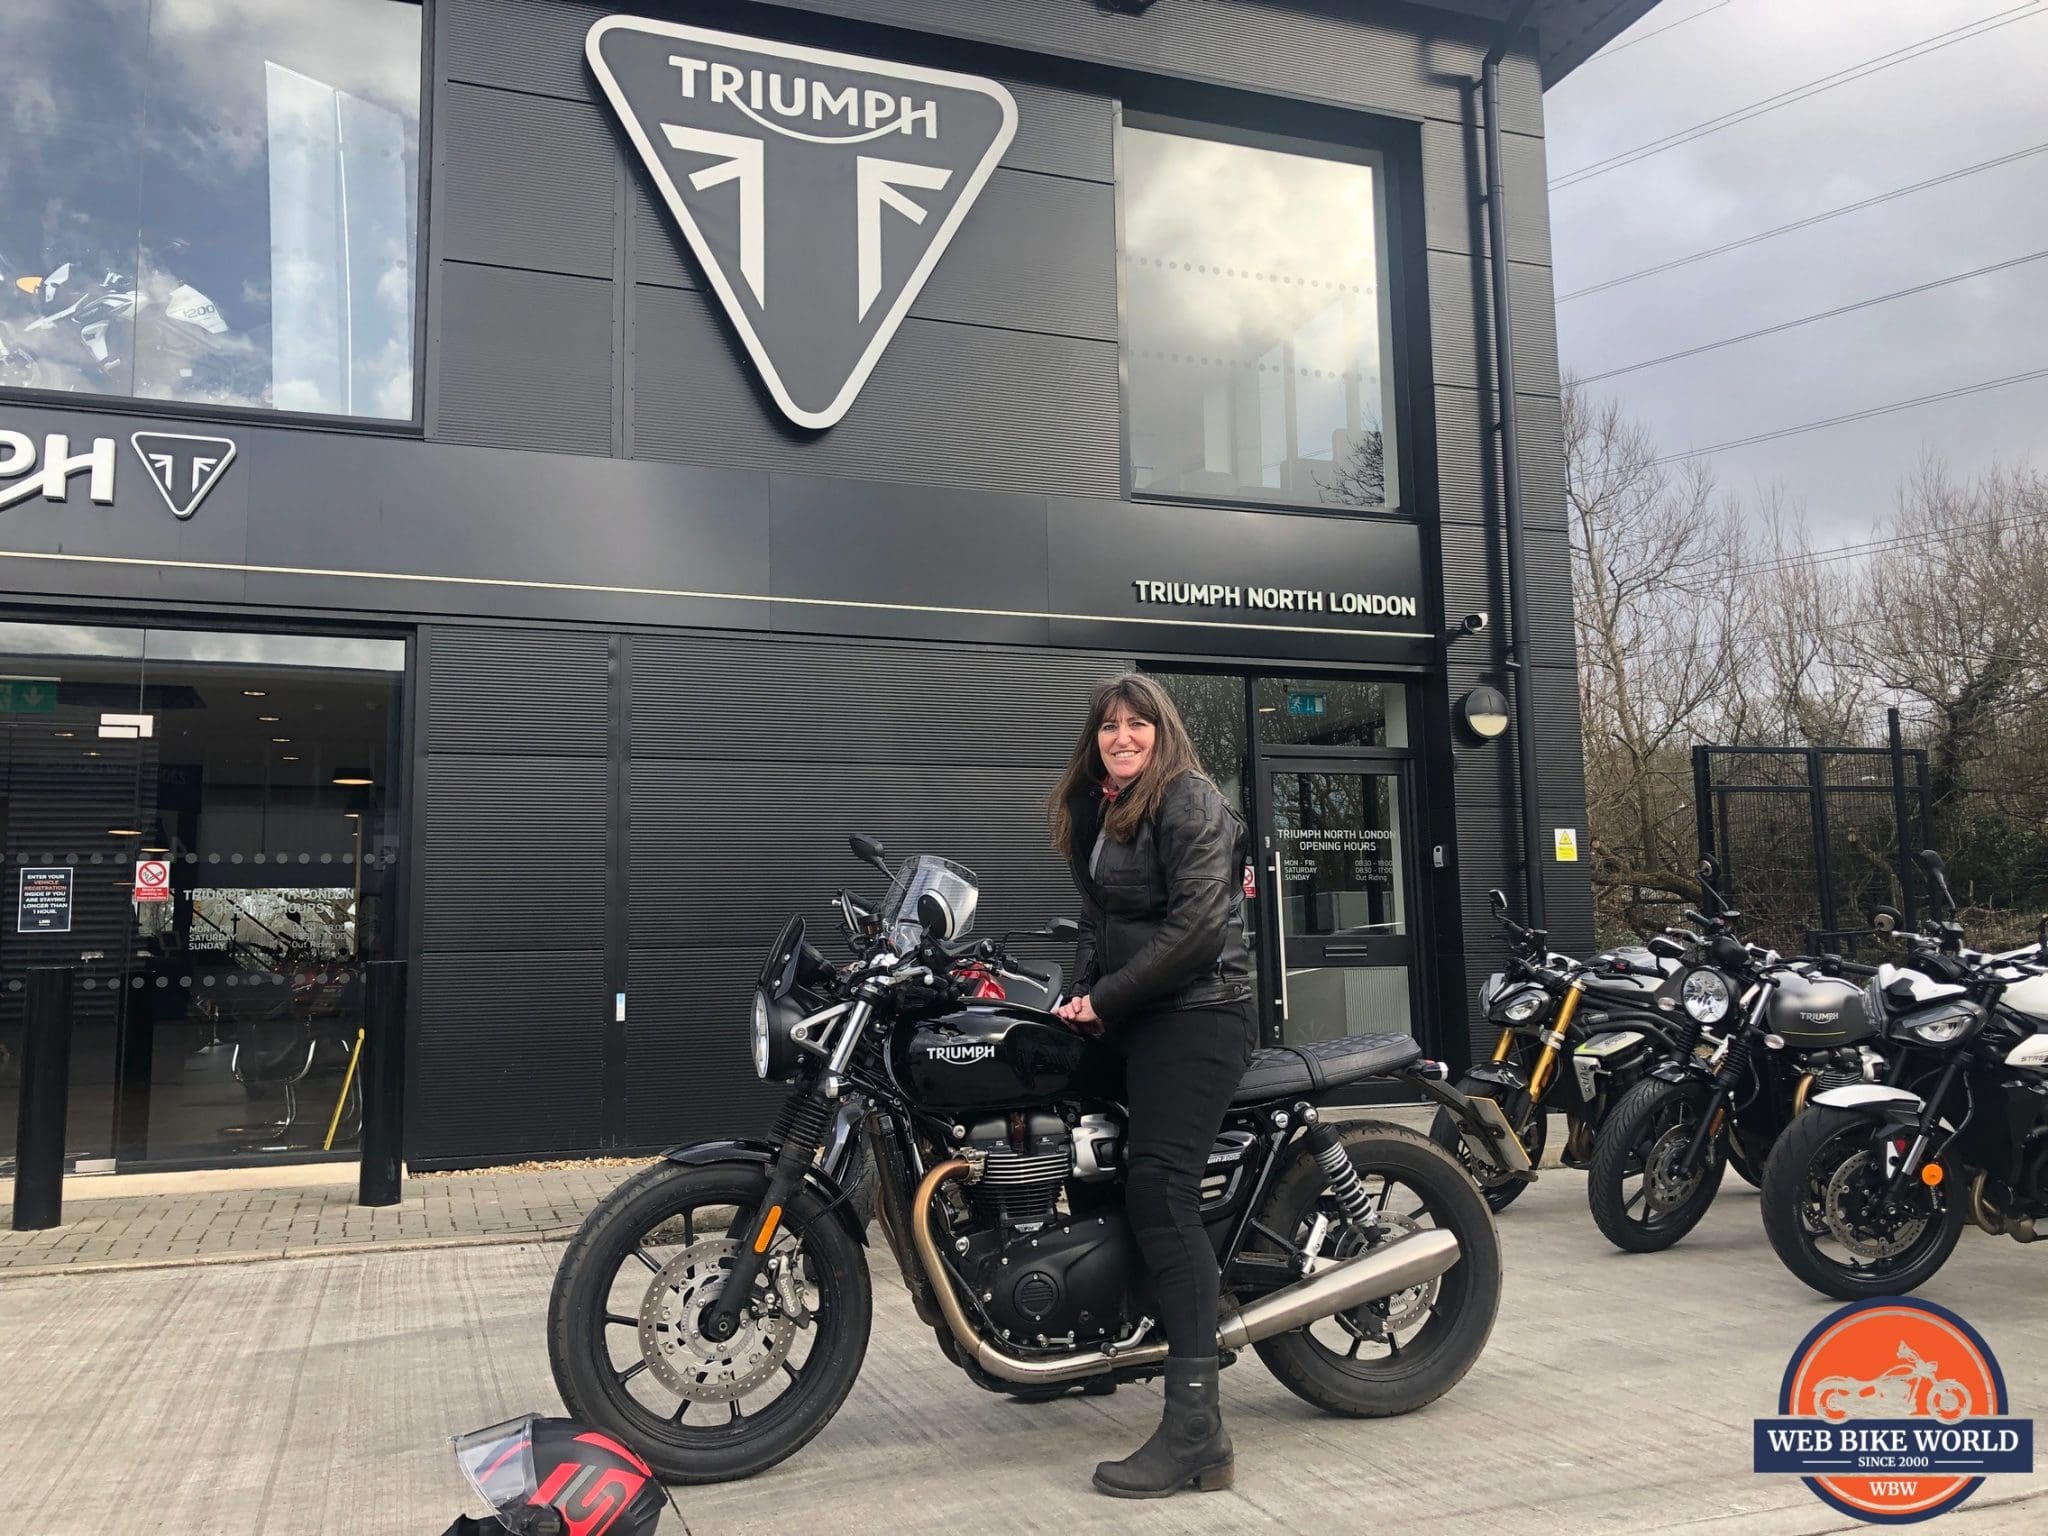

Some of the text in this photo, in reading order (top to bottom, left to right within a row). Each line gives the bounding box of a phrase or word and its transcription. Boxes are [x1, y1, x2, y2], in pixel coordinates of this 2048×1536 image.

[668, 55, 937, 144] TRIUMPH
[1135, 580, 1416, 616] TRIUMPH NORTH LONDON
[1277, 829, 1396, 839] TRIUMPH NORTH LONDON
[1300, 841, 1376, 851] OPENING HOURS
[189, 933, 237, 942] SATURDAY
[188, 942, 226, 950] SUNDAY
[1800, 1012, 1839, 1023] TRIUMPH
[926, 1046, 995, 1065] TRIUMPH
[781, 1278, 795, 1312] brembo
